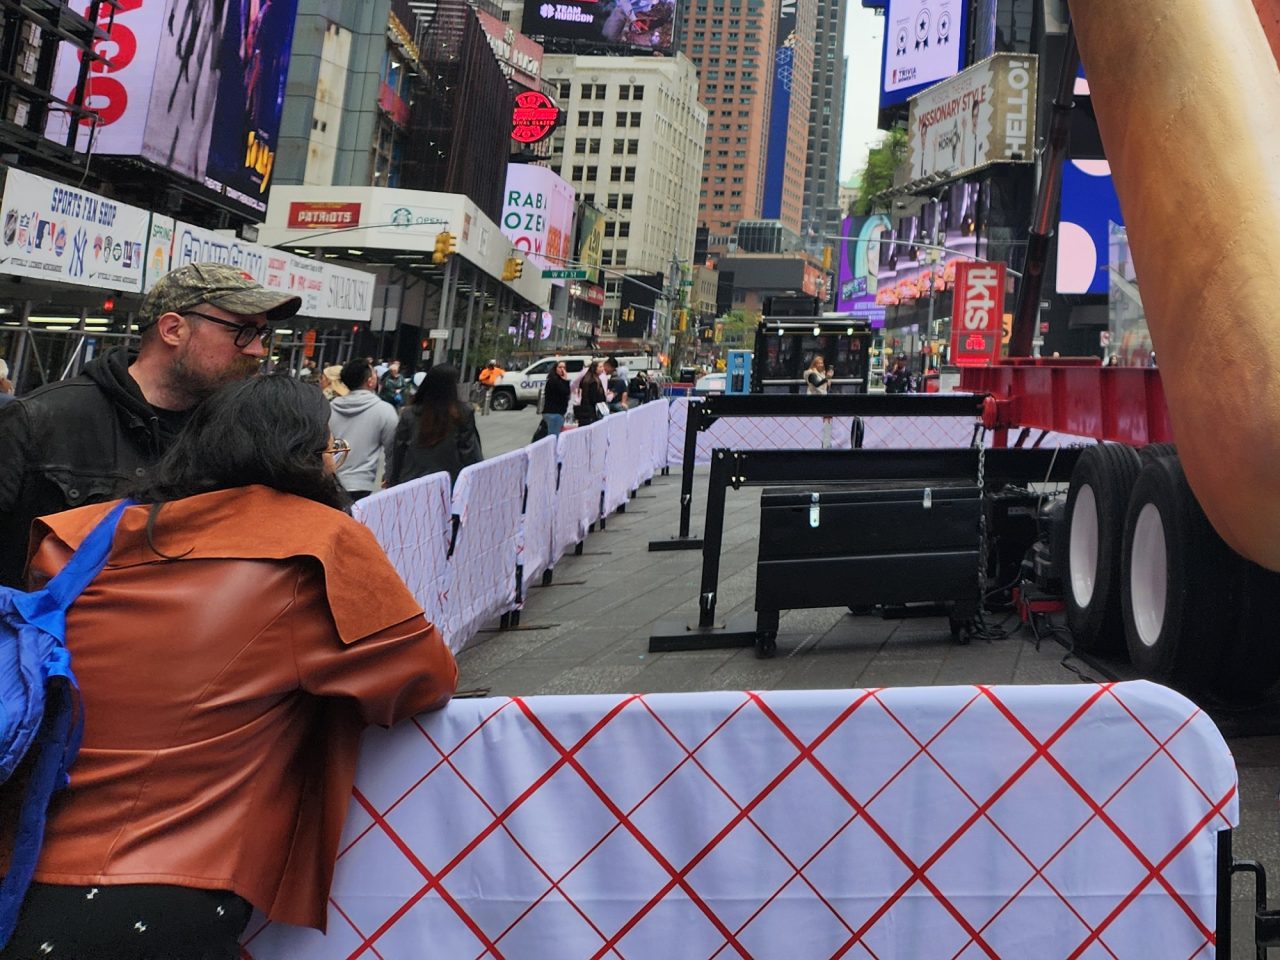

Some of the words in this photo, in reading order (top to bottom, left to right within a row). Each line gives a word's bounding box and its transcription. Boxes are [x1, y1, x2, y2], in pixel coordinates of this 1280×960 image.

[556, 4, 581, 13] TEAM
[555, 11, 594, 23] RUBICON
[898, 67, 917, 77] TRIVIA
[917, 99, 962, 132] MISSIONARY
[962, 84, 988, 112] STYLE
[1004, 60, 1030, 157] HELLO!
[51, 187, 82, 218] SPORTS
[82, 197, 98, 222] FAN
[99, 203, 117, 227] SHOP
[508, 190, 542, 209] RAB
[416, 216, 443, 225] OPEN
[152, 225, 172, 241] SPRING
[964, 266, 998, 330] tkts
[521, 380, 545, 389] OUTF
